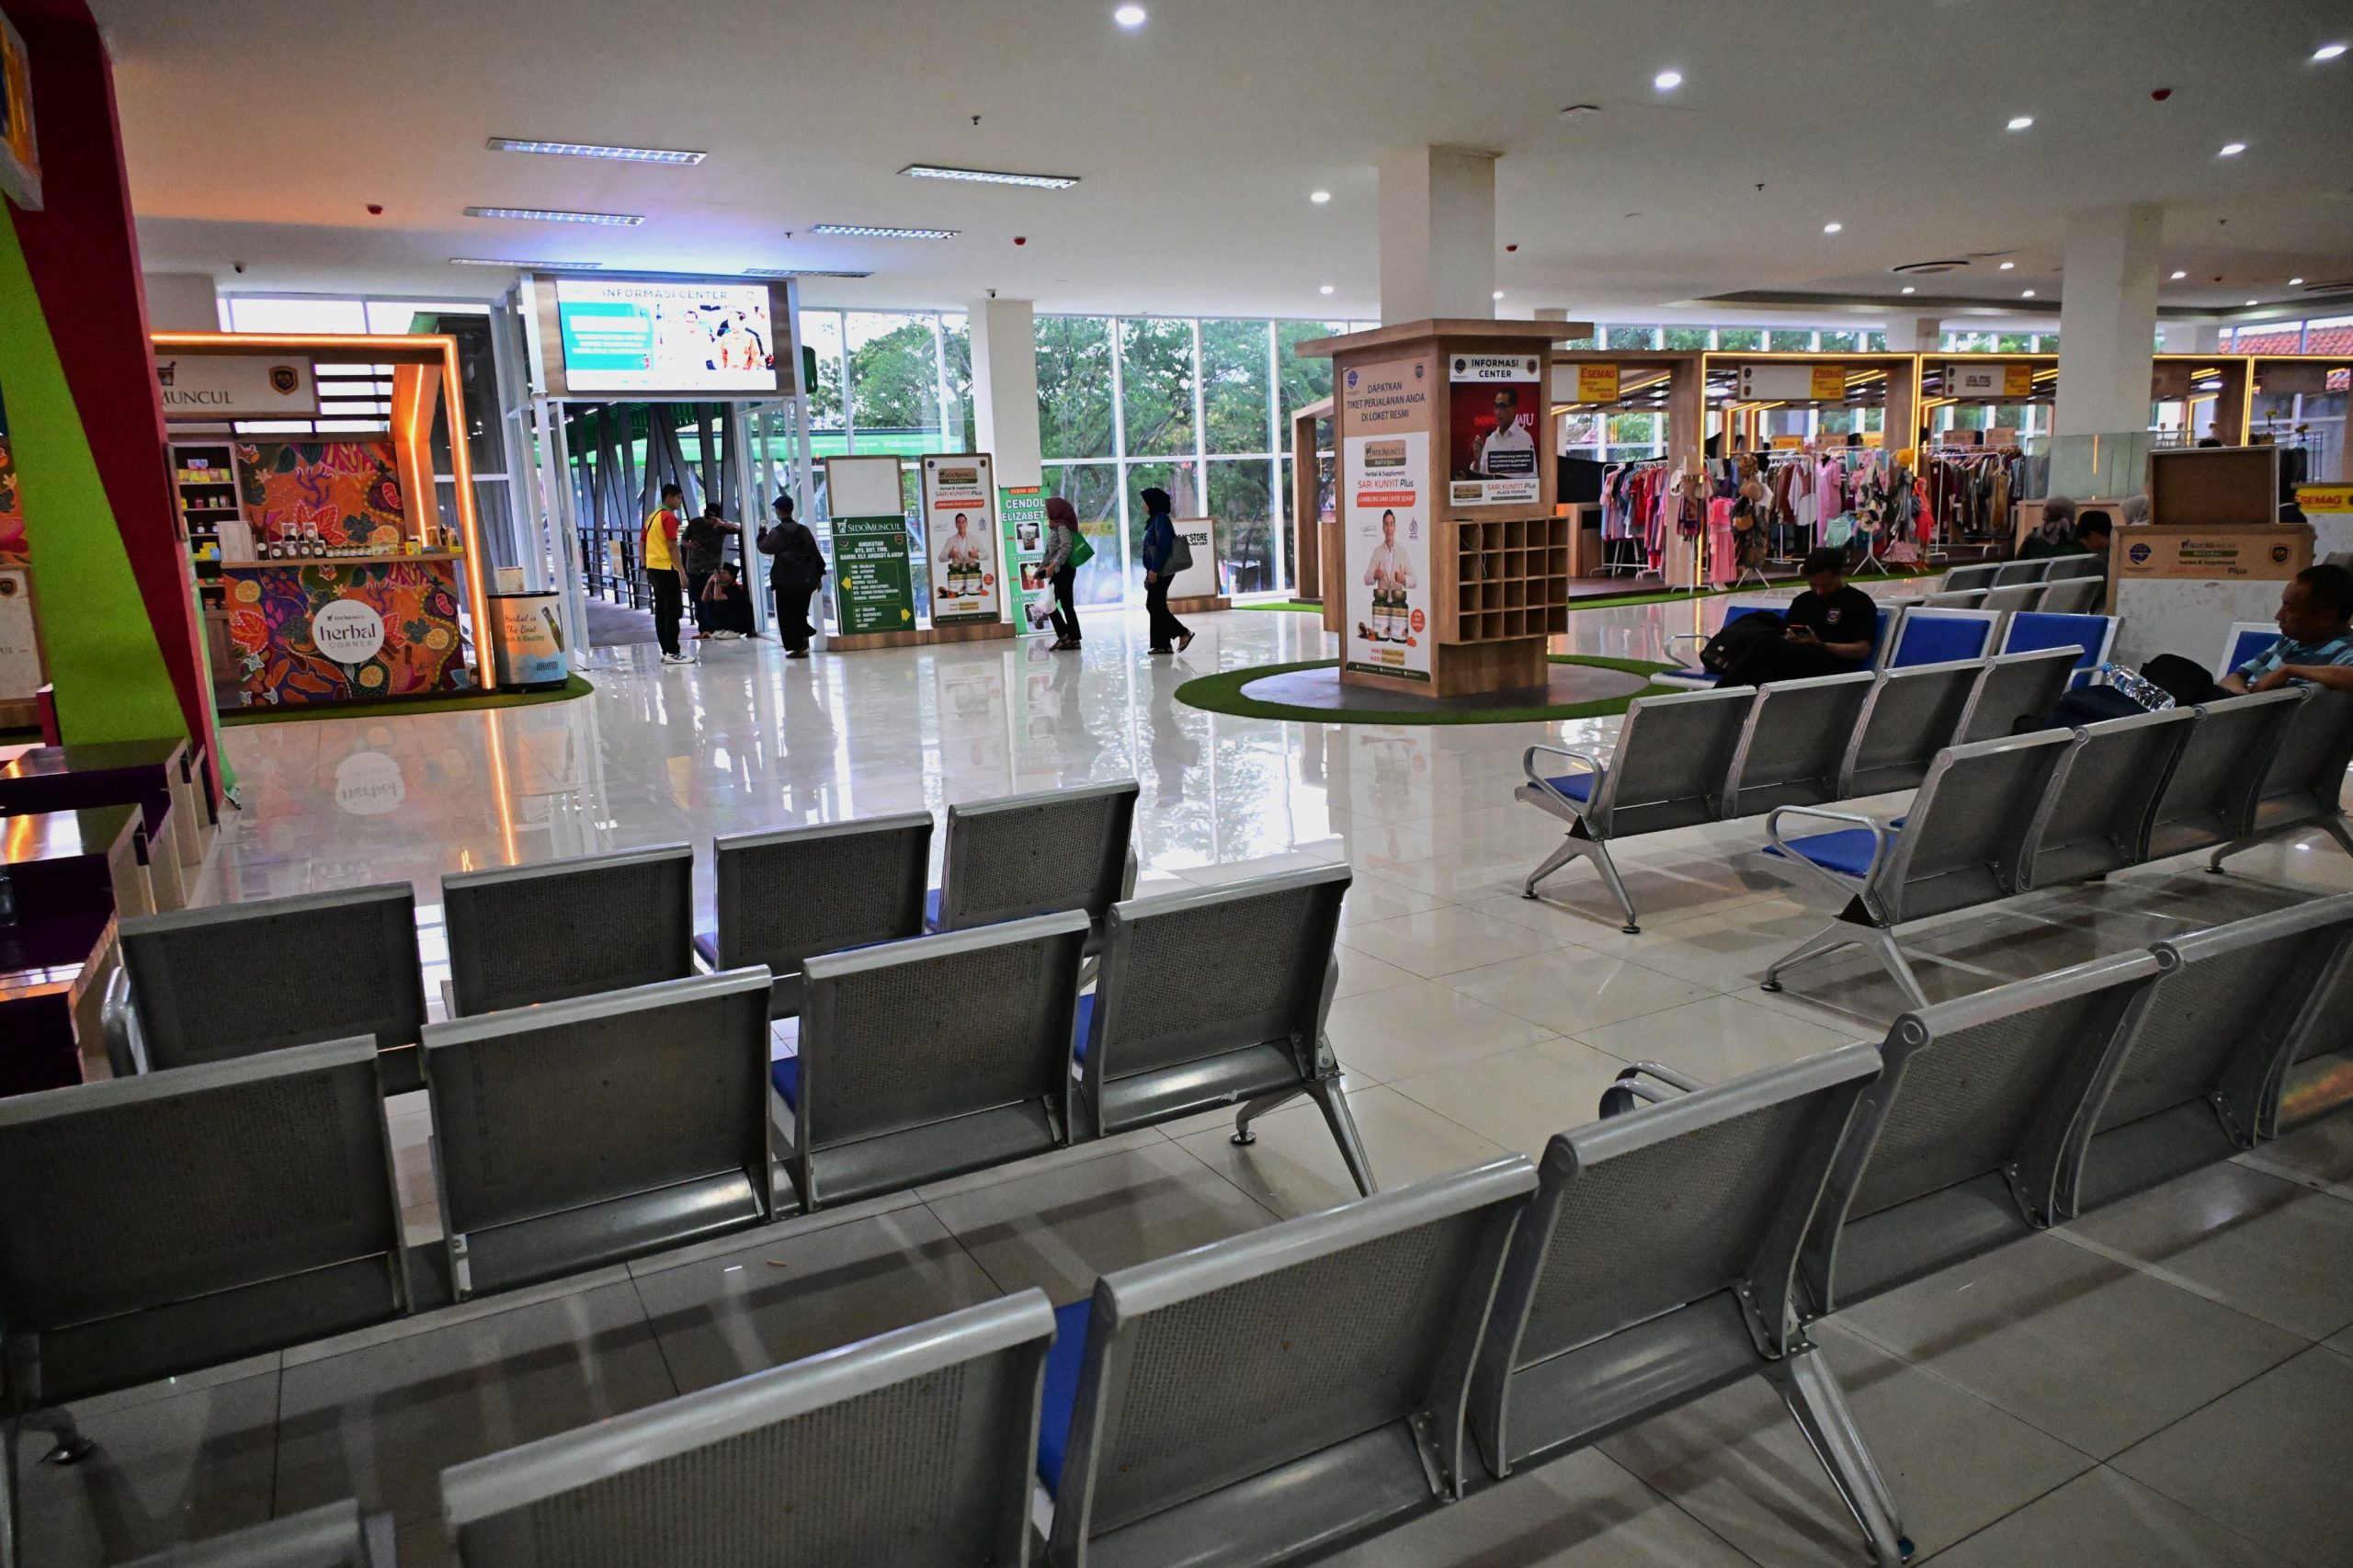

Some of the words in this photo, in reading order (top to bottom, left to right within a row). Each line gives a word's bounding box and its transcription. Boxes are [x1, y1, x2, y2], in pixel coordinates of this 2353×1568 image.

[603, 289, 676, 299] INFORMASI
[679, 290, 728, 300] CENTER
[1472, 358, 1519, 368] INFORMASI
[1479, 369, 1512, 378] CENTER
[1580, 368, 1616, 379] ESEMAG
[1367, 381, 1403, 394] DAPATKAN
[1347, 400, 1363, 410] TIKET
[1364, 395, 1405, 408] PERJALANAN
[1405, 392, 1426, 403] ANDA
[1361, 413, 1369, 422] DI
[1370, 411, 1389, 421] LOKET
[1390, 409, 1410, 419] RESMI
[1358, 480, 1373, 489] SARI
[1374, 479, 1399, 488] KUNYIT
[1400, 478, 1415, 488] Plus
[1006, 498, 1046, 509] CENDOL
[1002, 511, 1048, 521] ELIZABET
[847, 522, 902, 533] SIDOMUNCUL
[1189, 532, 1208, 542] STORE
[2227, 567, 2247, 575] Plus
[320, 623, 376, 642] herbal
[506, 625, 518, 634] The
[329, 641, 373, 649] CORNER
